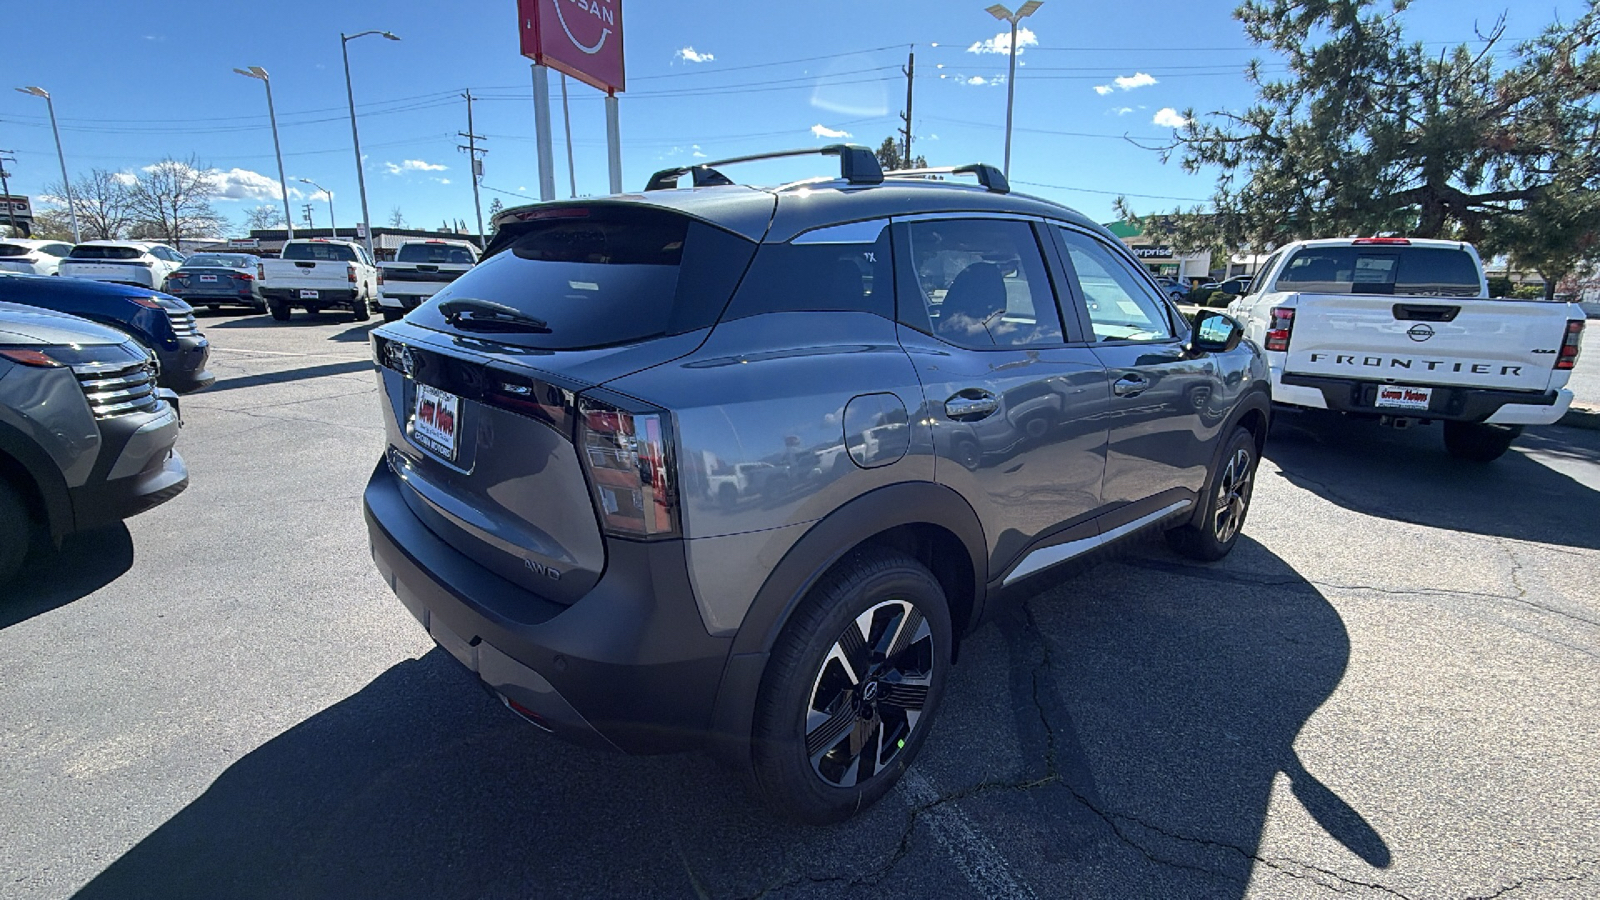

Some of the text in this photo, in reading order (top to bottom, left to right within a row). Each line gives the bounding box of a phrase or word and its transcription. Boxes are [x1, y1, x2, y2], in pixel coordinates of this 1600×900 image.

[1310, 353, 1522, 376] FRONTIER
[430, 440, 451, 457] MOTORS
[524, 558, 561, 581] AWD
